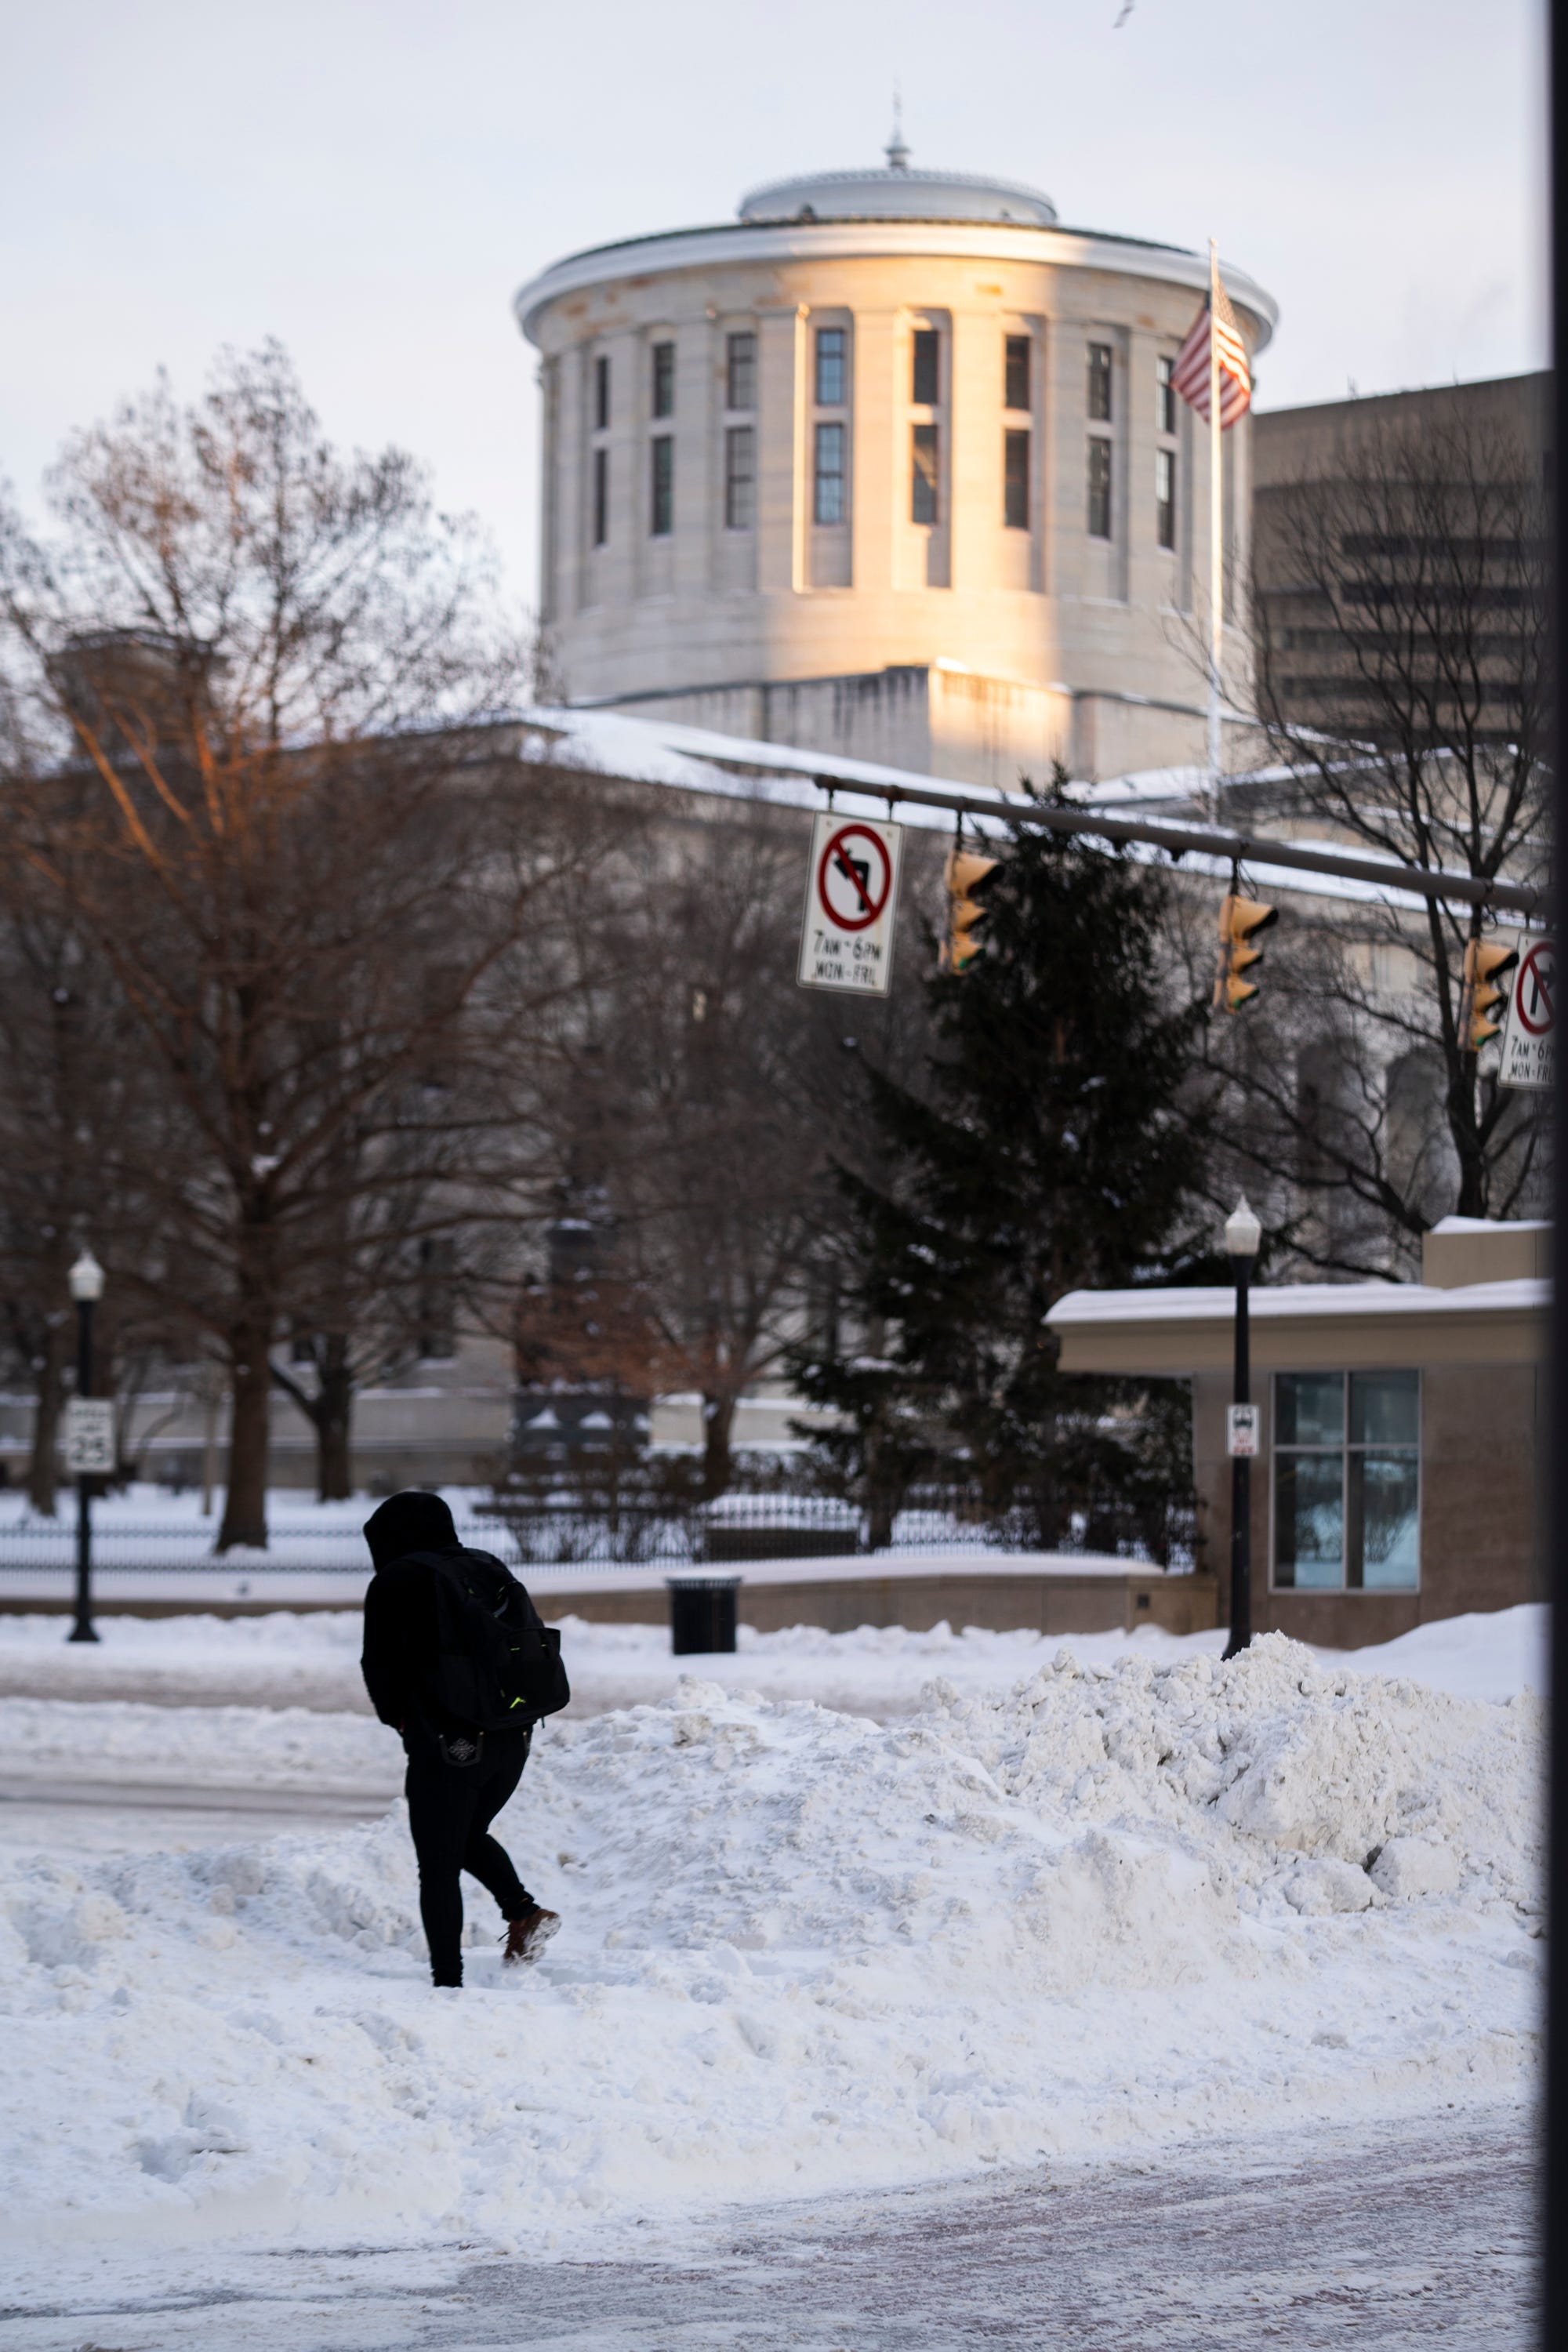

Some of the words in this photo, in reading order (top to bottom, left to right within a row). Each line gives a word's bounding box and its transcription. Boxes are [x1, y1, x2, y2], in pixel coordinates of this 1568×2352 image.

[816, 960, 844, 980] MON
[1511, 1035, 1530, 1057] 7AM
[1511, 1061, 1530, 1080] MON
